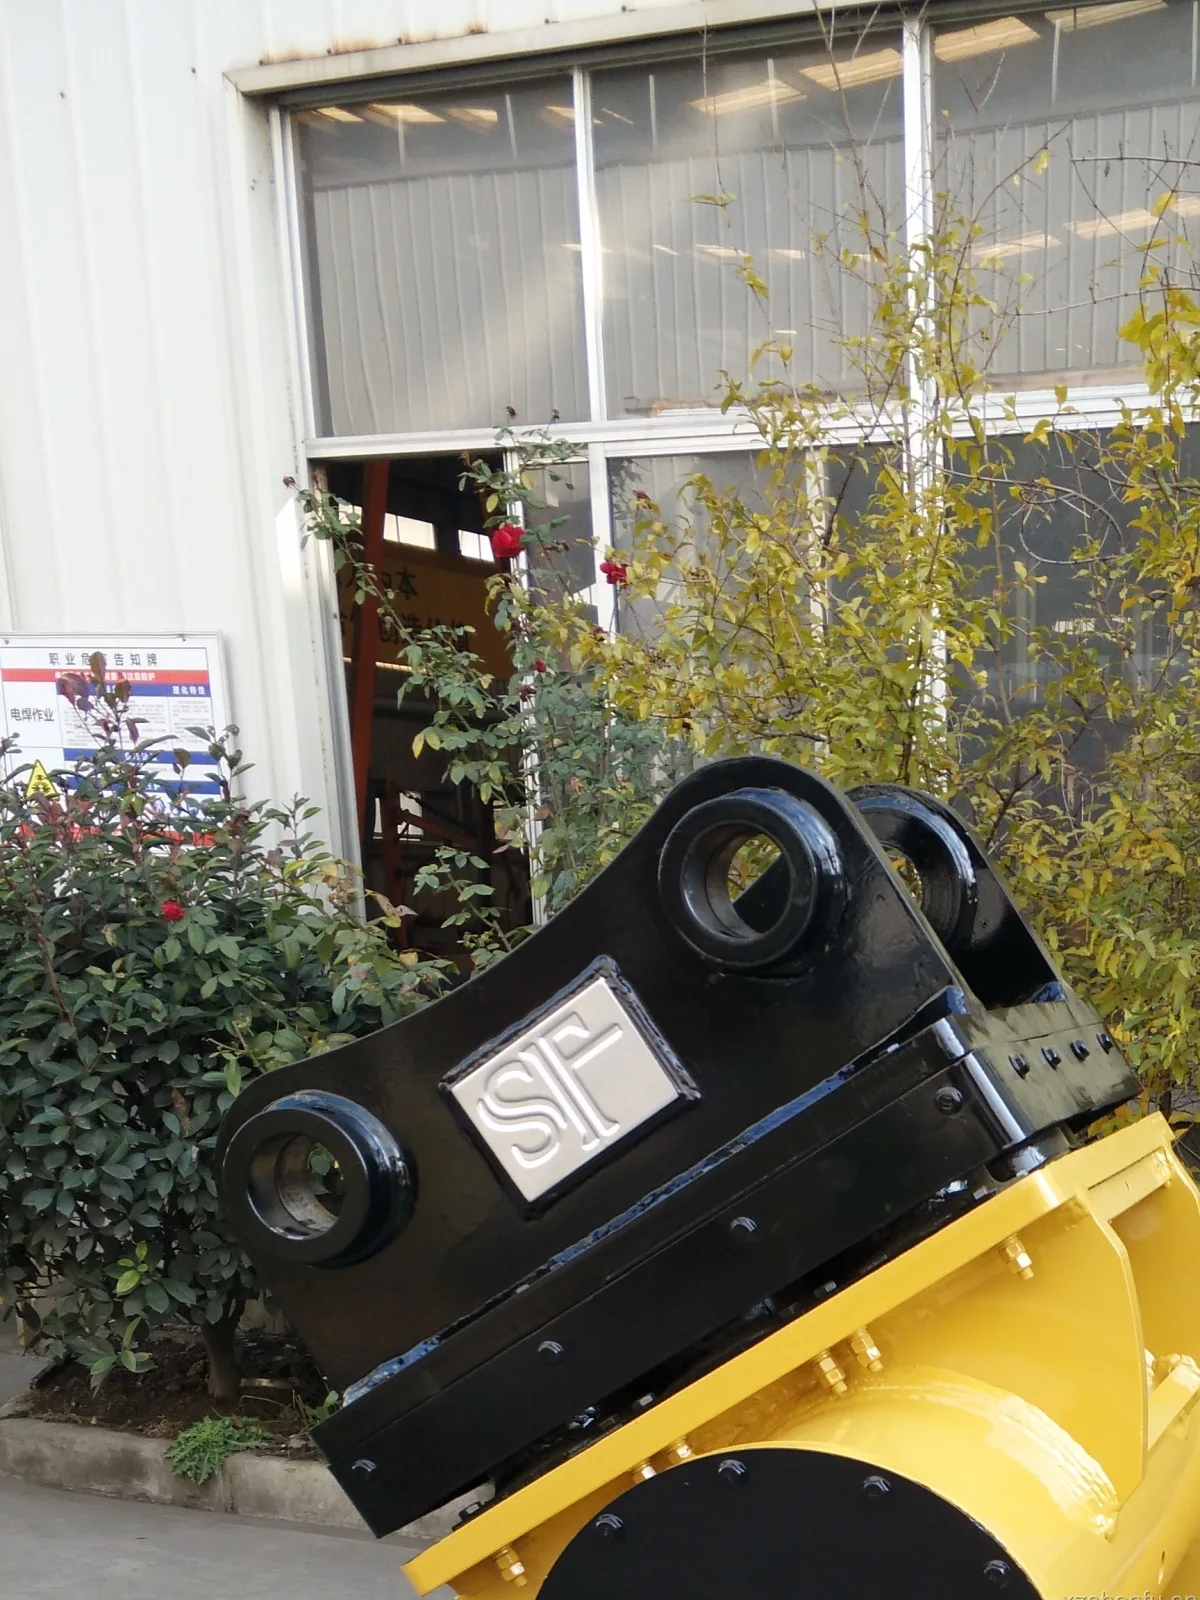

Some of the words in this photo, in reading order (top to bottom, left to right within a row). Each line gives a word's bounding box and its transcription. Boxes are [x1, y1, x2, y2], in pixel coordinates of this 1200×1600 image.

[48, 652, 157, 667] 职业危告知牌
[10, 707, 55, 722] 电焊作业
